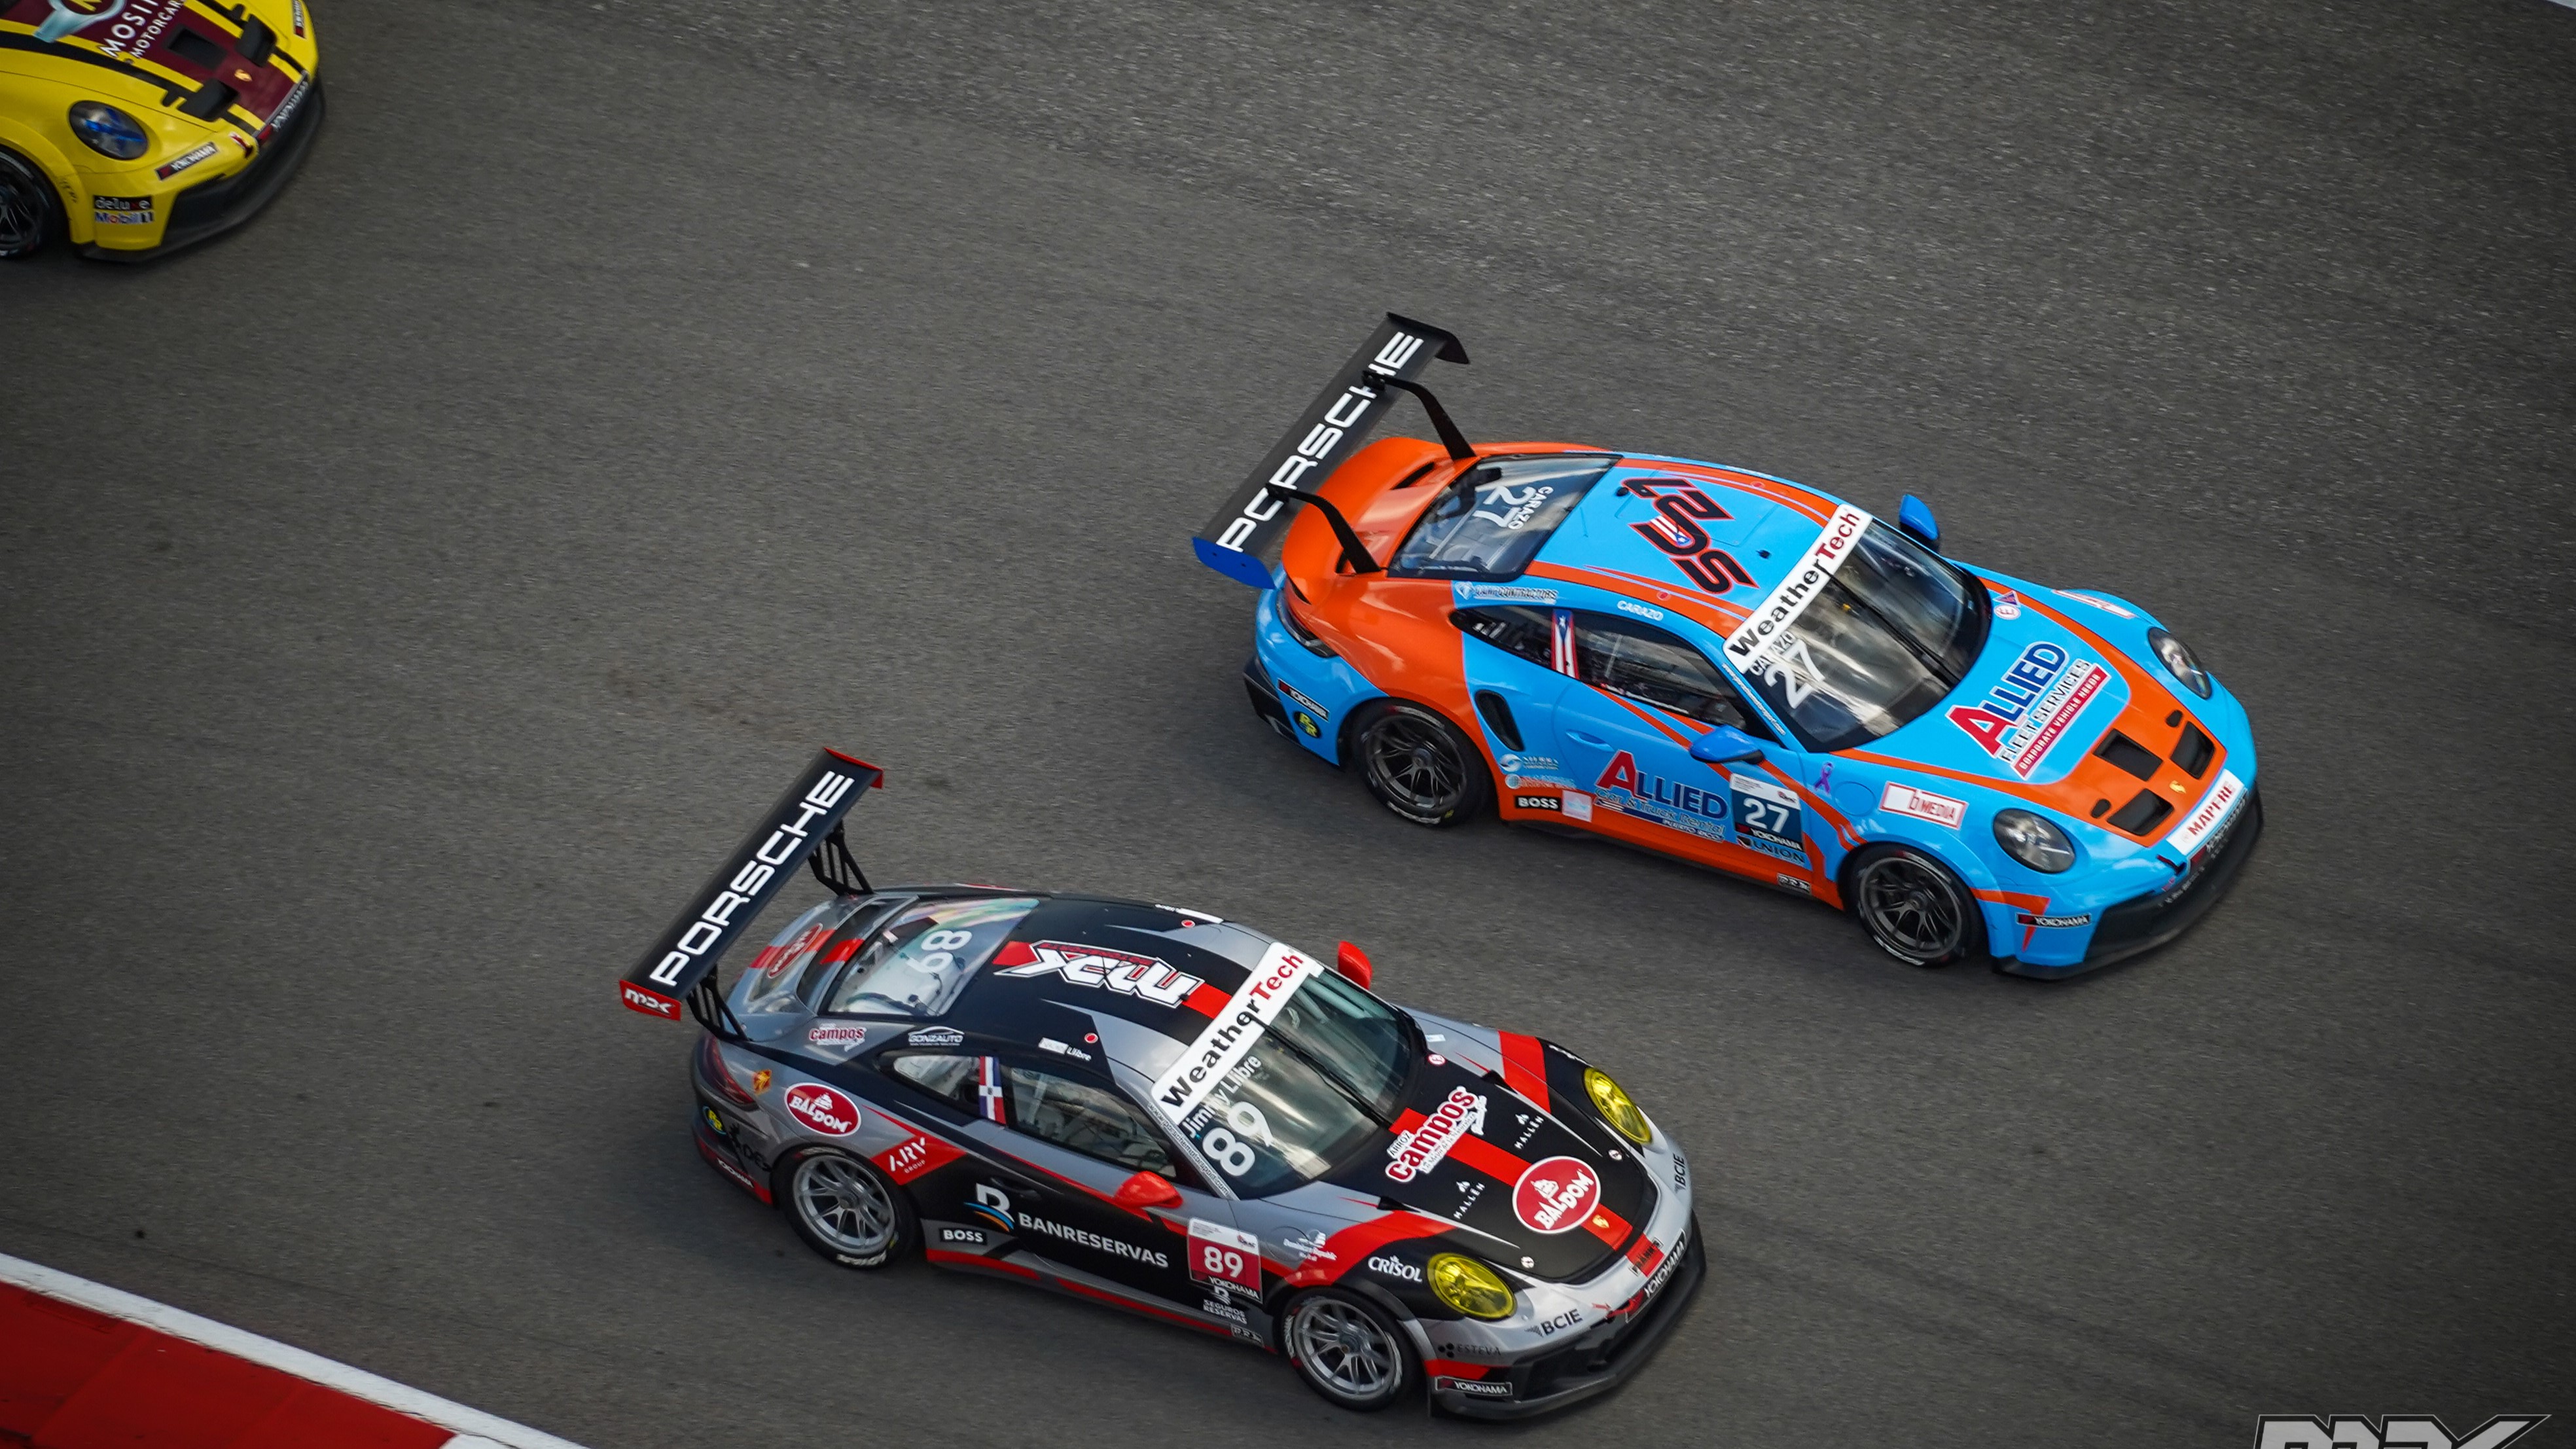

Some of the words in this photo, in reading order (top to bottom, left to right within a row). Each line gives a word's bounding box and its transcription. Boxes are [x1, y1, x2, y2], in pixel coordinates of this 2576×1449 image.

[98, 0, 158, 58] MOSI
[1472, 486, 1537, 528] 27
[1508, 486, 1554, 529] CARAZO
[1728, 511, 1861, 658] WeatherTech
[1617, 600, 1664, 620] CARAZO
[1764, 638, 1825, 709] 27
[1948, 642, 2067, 757] ALLIED
[1518, 797, 1558, 809] BOSS
[1594, 749, 1728, 820] ALLIED
[1744, 798, 1789, 833] 27
[649, 770, 855, 986] PORSCHE
[1161, 953, 1304, 1108] WeatherTech
[1223, 1055, 1262, 1094] Llibre
[789, 1095, 852, 1134] BALDOM
[1202, 1101, 1274, 1177] 89
[1387, 1091, 1475, 1181] campos
[1673, 1153, 1687, 1187] BCIE
[1533, 1168, 1595, 1230] BALDOM
[944, 1230, 983, 1243] BOSS
[1018, 1212, 1169, 1268] BANRESERVAS
[1204, 1246, 1243, 1278] 89
[1204, 1305, 1247, 1325] RESERVAS
[1541, 1309, 1584, 1336] BCIE
[1454, 1381, 1508, 1395] YOKOHAMA
